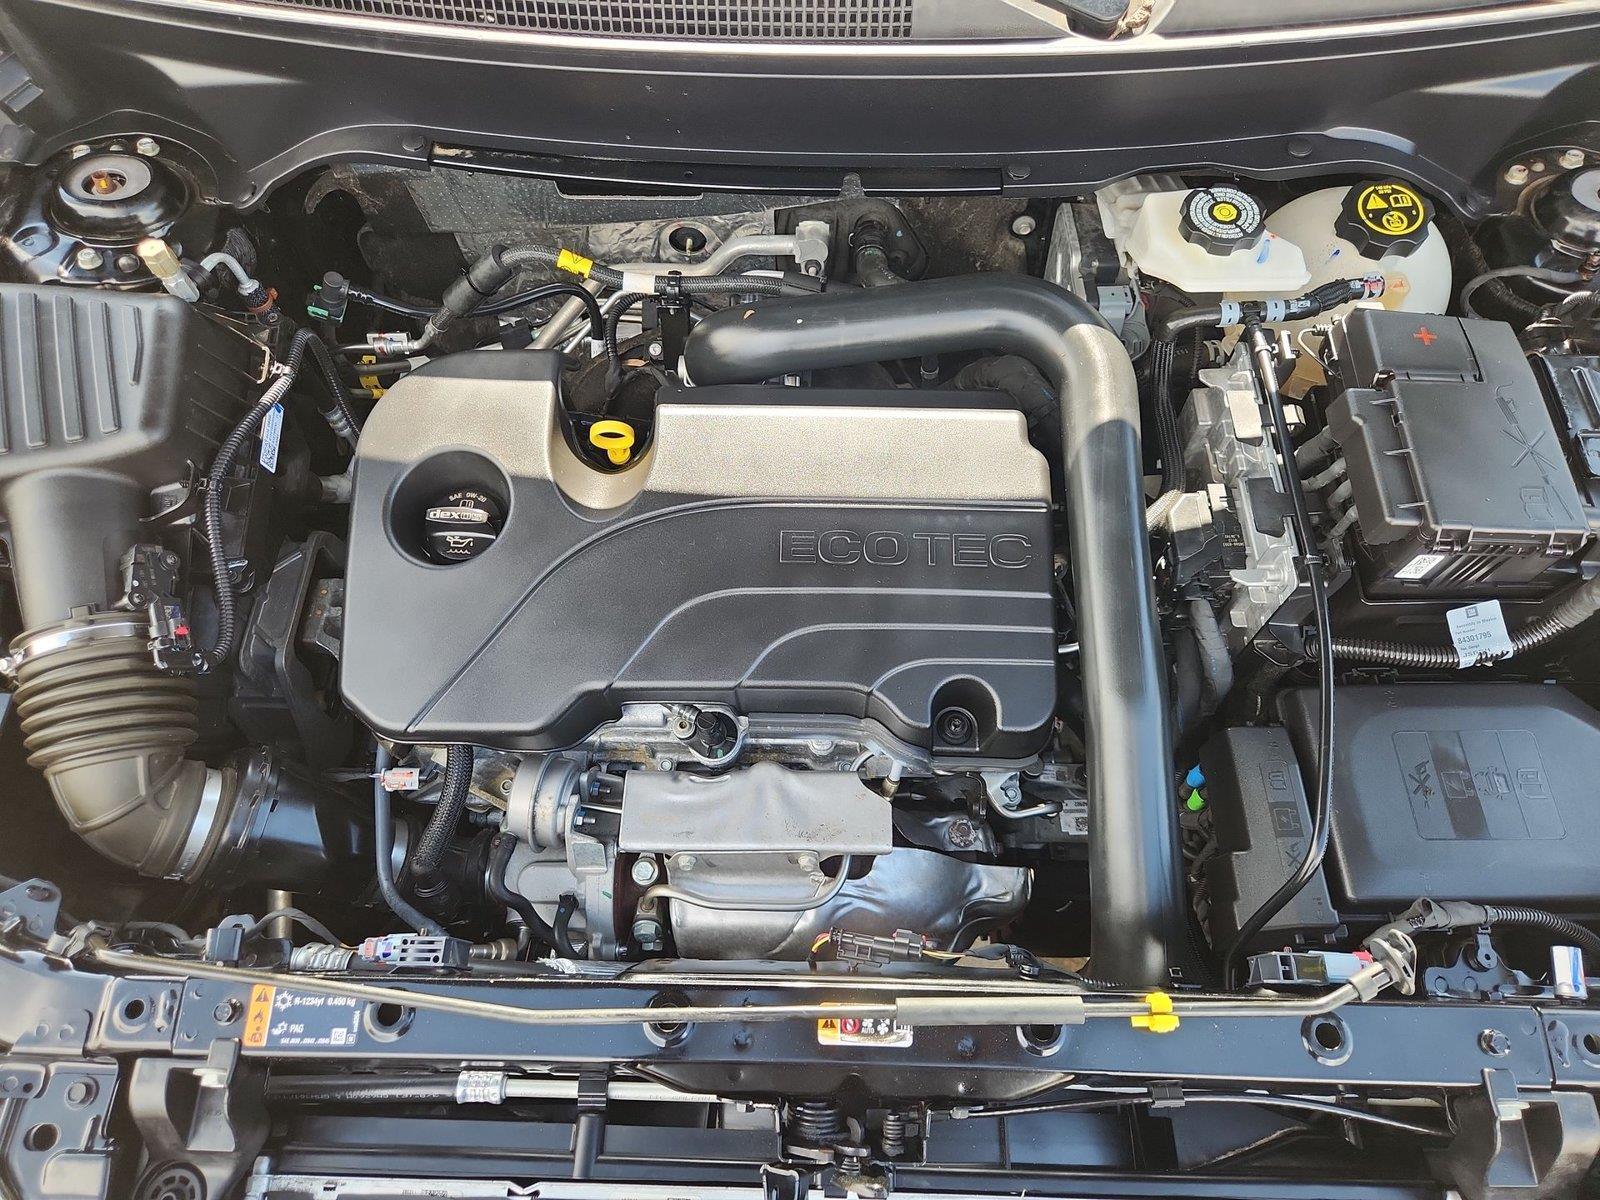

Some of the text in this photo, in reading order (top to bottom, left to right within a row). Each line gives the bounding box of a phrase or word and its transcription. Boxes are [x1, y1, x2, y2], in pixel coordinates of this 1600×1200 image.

[448, 492, 463, 502] SAE
[779, 530, 1032, 569] ECOTEC
[289, 1023, 305, 1034] PAG
